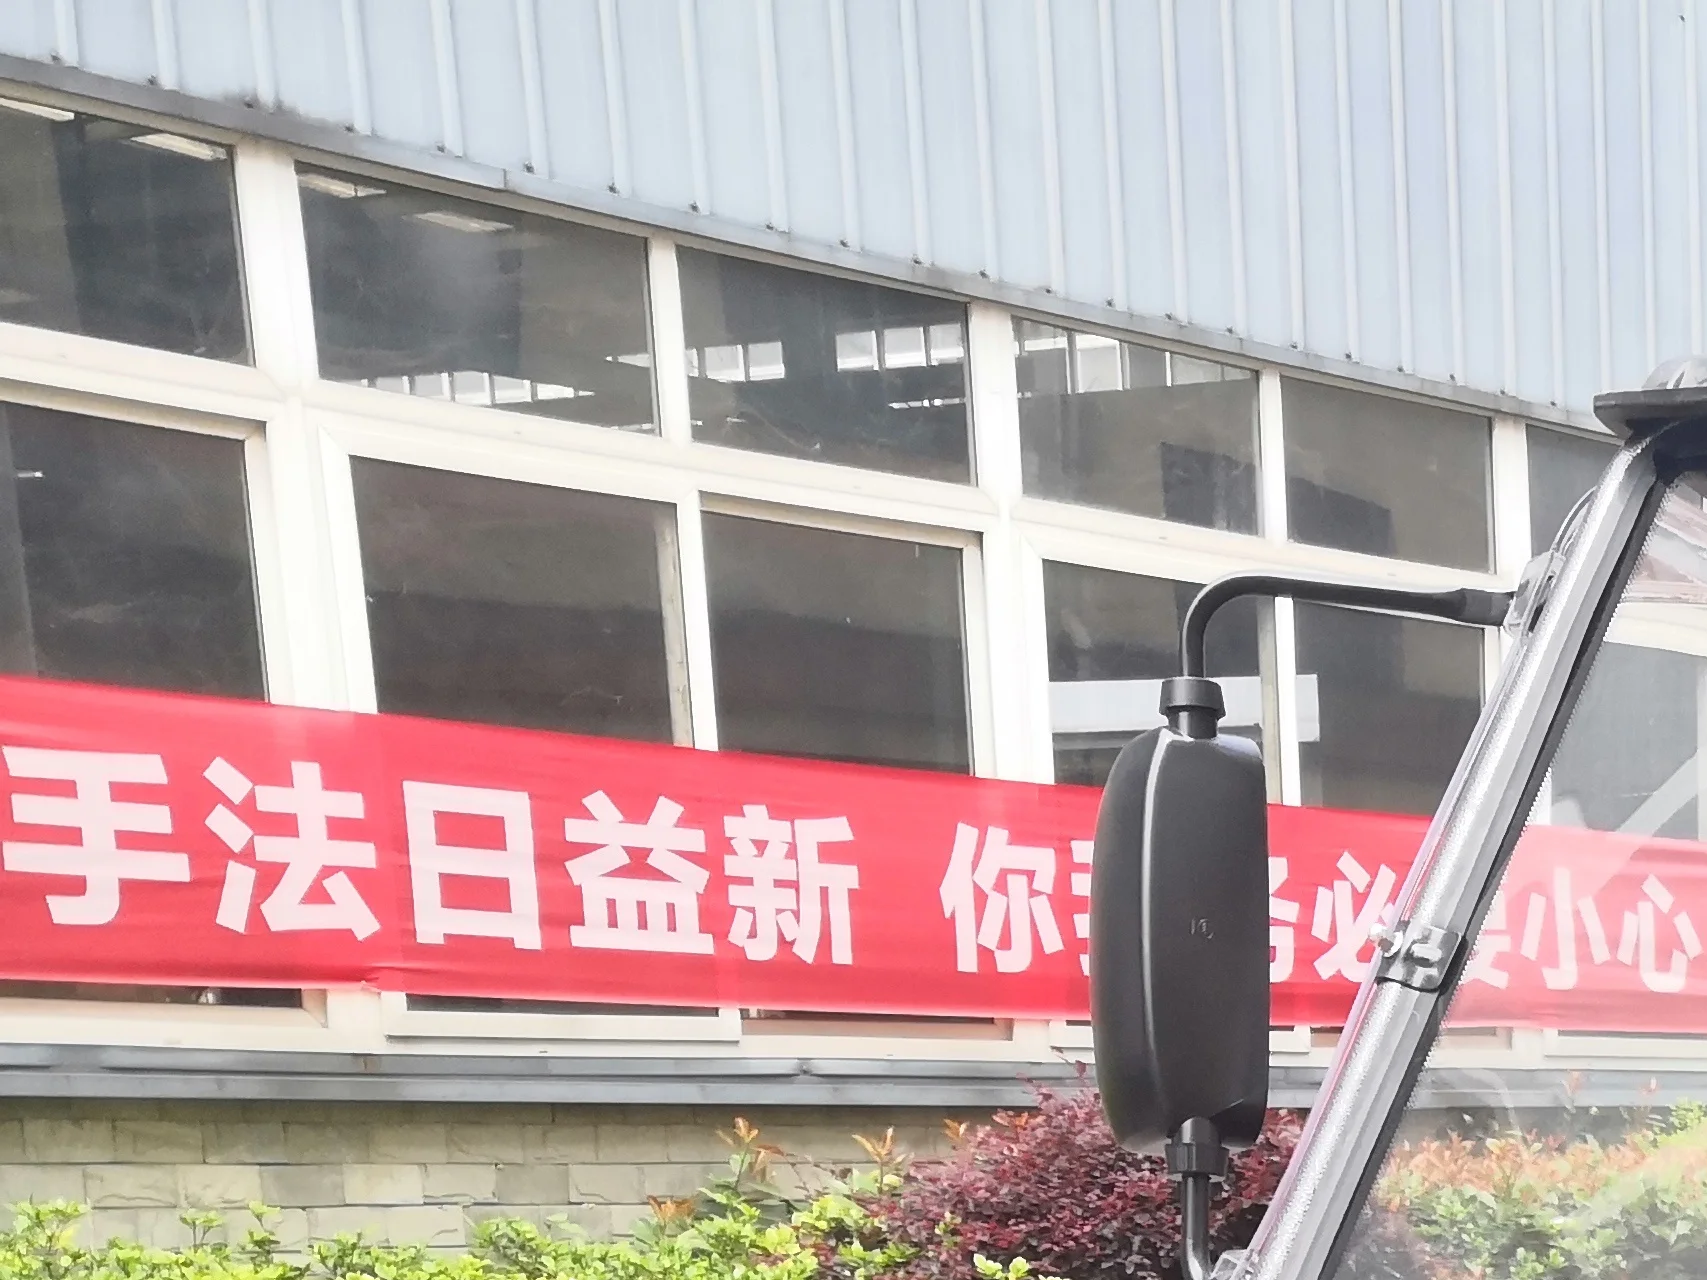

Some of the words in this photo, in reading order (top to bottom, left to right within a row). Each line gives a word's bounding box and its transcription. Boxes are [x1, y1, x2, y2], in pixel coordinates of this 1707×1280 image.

[2, 745, 861, 966] 手法日益新
[939, 821, 1703, 994] 你必小心
